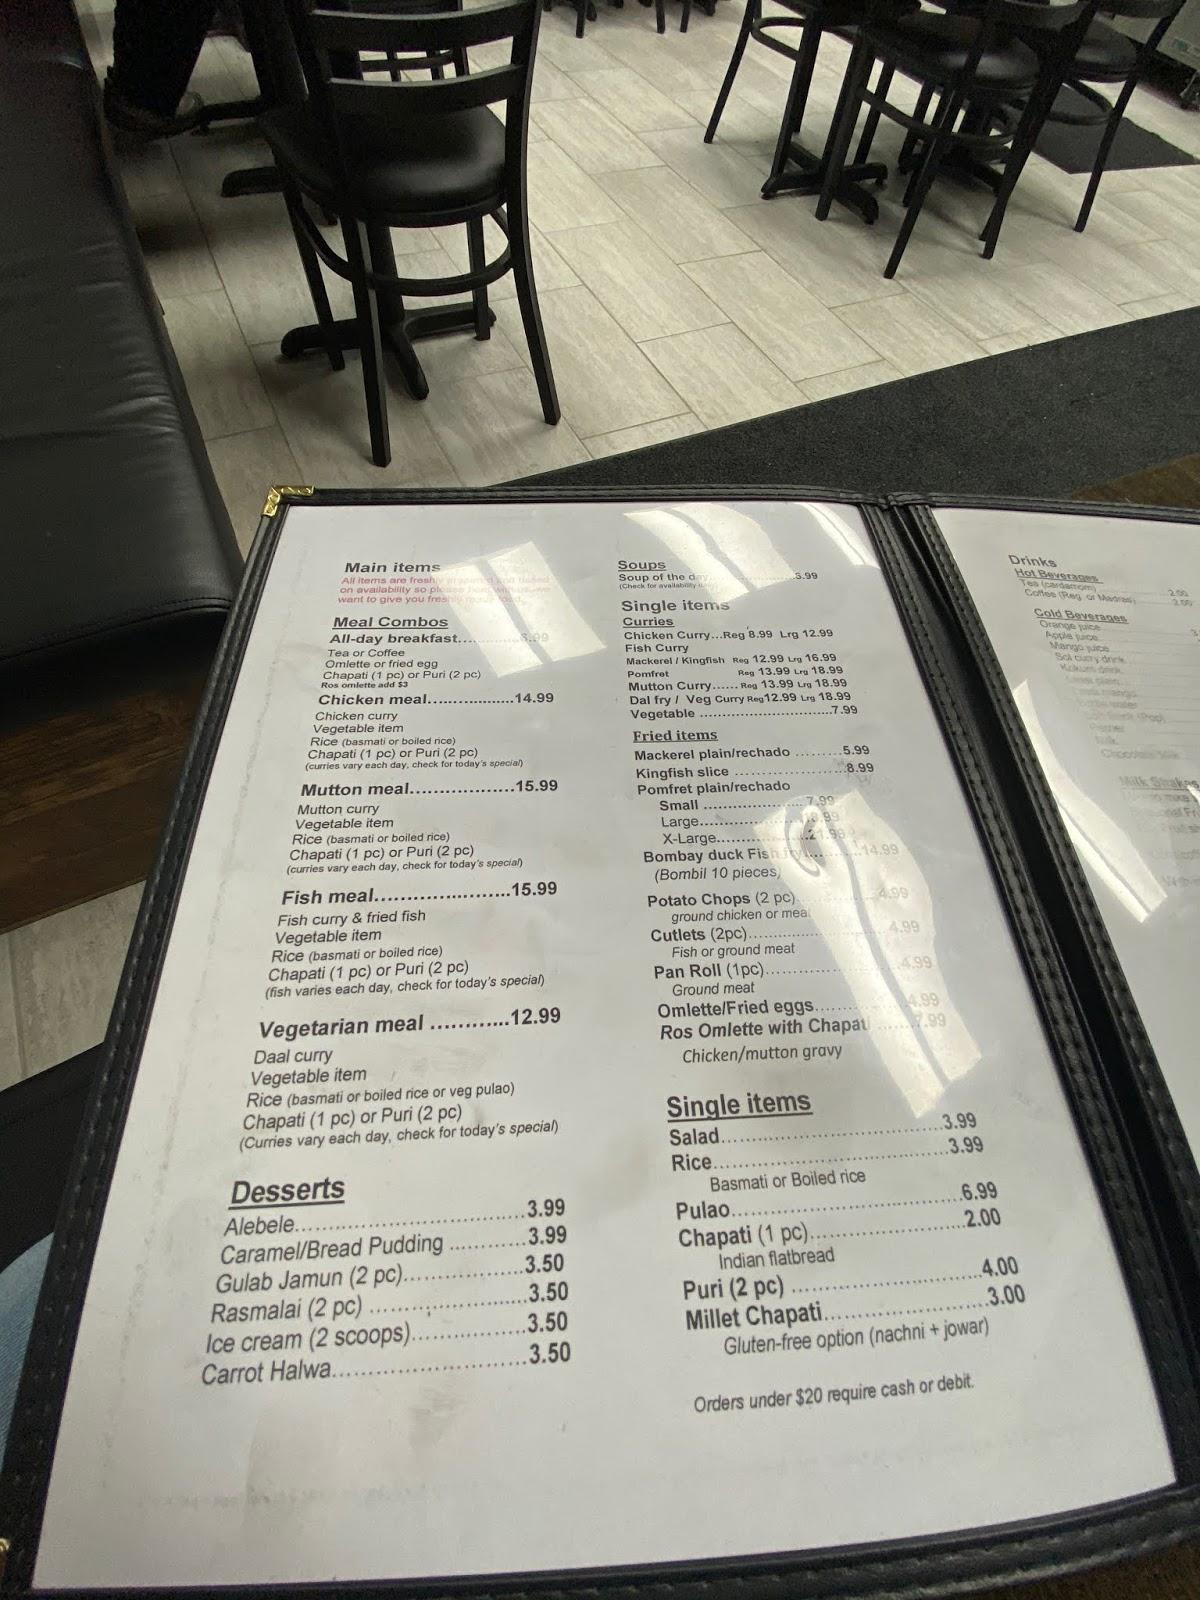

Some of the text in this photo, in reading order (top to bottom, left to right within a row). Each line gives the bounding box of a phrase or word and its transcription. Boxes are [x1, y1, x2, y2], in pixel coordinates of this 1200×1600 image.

[345, 562, 441, 573] Main items
[618, 560, 666, 571] Soups
[1009, 555, 1057, 567] Drinks
[619, 573, 685, 582] Soup of the
[1015, 568, 1034, 577] Hot
[380, 595, 401, 604] give
[405, 596, 420, 604] you
[621, 600, 730, 613] Single items
[1034, 608, 1062, 618] Cold
[334, 617, 448, 628] Meal Combos
[623, 617, 674, 626] Curries
[329, 634, 384, 645] All-day
[624, 631, 673, 640] Chicken
[748, 630, 773, 639] 8.99
[779, 630, 799, 640] Lrg
[803, 629, 833, 638] 12.99
[327, 649, 349, 657] Tea
[367, 649, 405, 657] Coffee
[625, 643, 688, 653] Fish Curry
[325, 660, 438, 669] Omlette or fried egg
[626, 657, 673, 666] Mackerel
[682, 656, 725, 665] Kingfish
[753, 655, 784, 663] 12.99
[805, 653, 836, 662] 16.99
[323, 671, 368, 682] Chapati
[371, 671, 383, 680] (1
[386, 671, 405, 681] pc)
[423, 671, 446, 679] Puri
[449, 670, 460, 679] (2
[463, 670, 481, 680] pc)
[627, 670, 669, 678] Pomfret
[758, 667, 790, 676] 13.99
[811, 666, 843, 674] 18.99
[318, 694, 386, 705] Chicken
[630, 695, 651, 705] Dal
[654, 694, 671, 706] fry
[686, 694, 711, 705] Veg
[715, 694, 744, 705] Curry
[801, 694, 815, 702] Lrg
[818, 692, 850, 701] 18.99
[631, 709, 695, 721] Vegetable
[633, 730, 717, 742] Fried items
[635, 747, 790, 762] Mackerel plain/rechado
[305, 762, 340, 771] (curries
[365, 761, 387, 769] each
[390, 761, 409, 769] day,
[412, 760, 439, 768] check
[441, 760, 453, 768] for
[455, 759, 487, 768] today's
[489, 758, 523, 768] special)
[636, 767, 729, 781] Kingfish slice
[295, 818, 394, 831] Vegetable item
[654, 867, 728, 882] (Bombil 10
[647, 895, 697, 907] Potato
[701, 893, 750, 907] Chops
[755, 892, 770, 906] (2
[278, 910, 426, 926] Fish curry & fried fish
[651, 928, 706, 942] Cutlets
[672, 943, 795, 959] Fish or ground meat
[654, 963, 721, 979] Pan Roll
[265, 974, 544, 999] (fish varies each day, check for today's special)
[658, 1002, 769, 1019] Omlette/Fried
[259, 1015, 423, 1042] Vegetarian meal
[660, 1018, 802, 1040] Ros Omlette with
[254, 1049, 333, 1064] Daal curry
[683, 1044, 842, 1063] Chicken/mutton gravy
[246, 1082, 515, 1107] Rice (basmati or boiled rice or veg pulao)
[667, 1094, 811, 1120] Single items
[710, 1170, 866, 1192] Basmati or Boiled rice
[231, 1177, 345, 1204] Desserts
[220, 1234, 444, 1265] Caramel/Bread Pudding
[719, 1247, 835, 1270] Indian flatbread
[683, 1275, 784, 1300] Puri (2 pc)
[210, 1295, 362, 1323] Rasmalai (2 pc)
[724, 1317, 990, 1355] Gluten-free option (nachni + jowar)
[694, 1373, 974, 1413] Orders under $20 require cash or debit.
